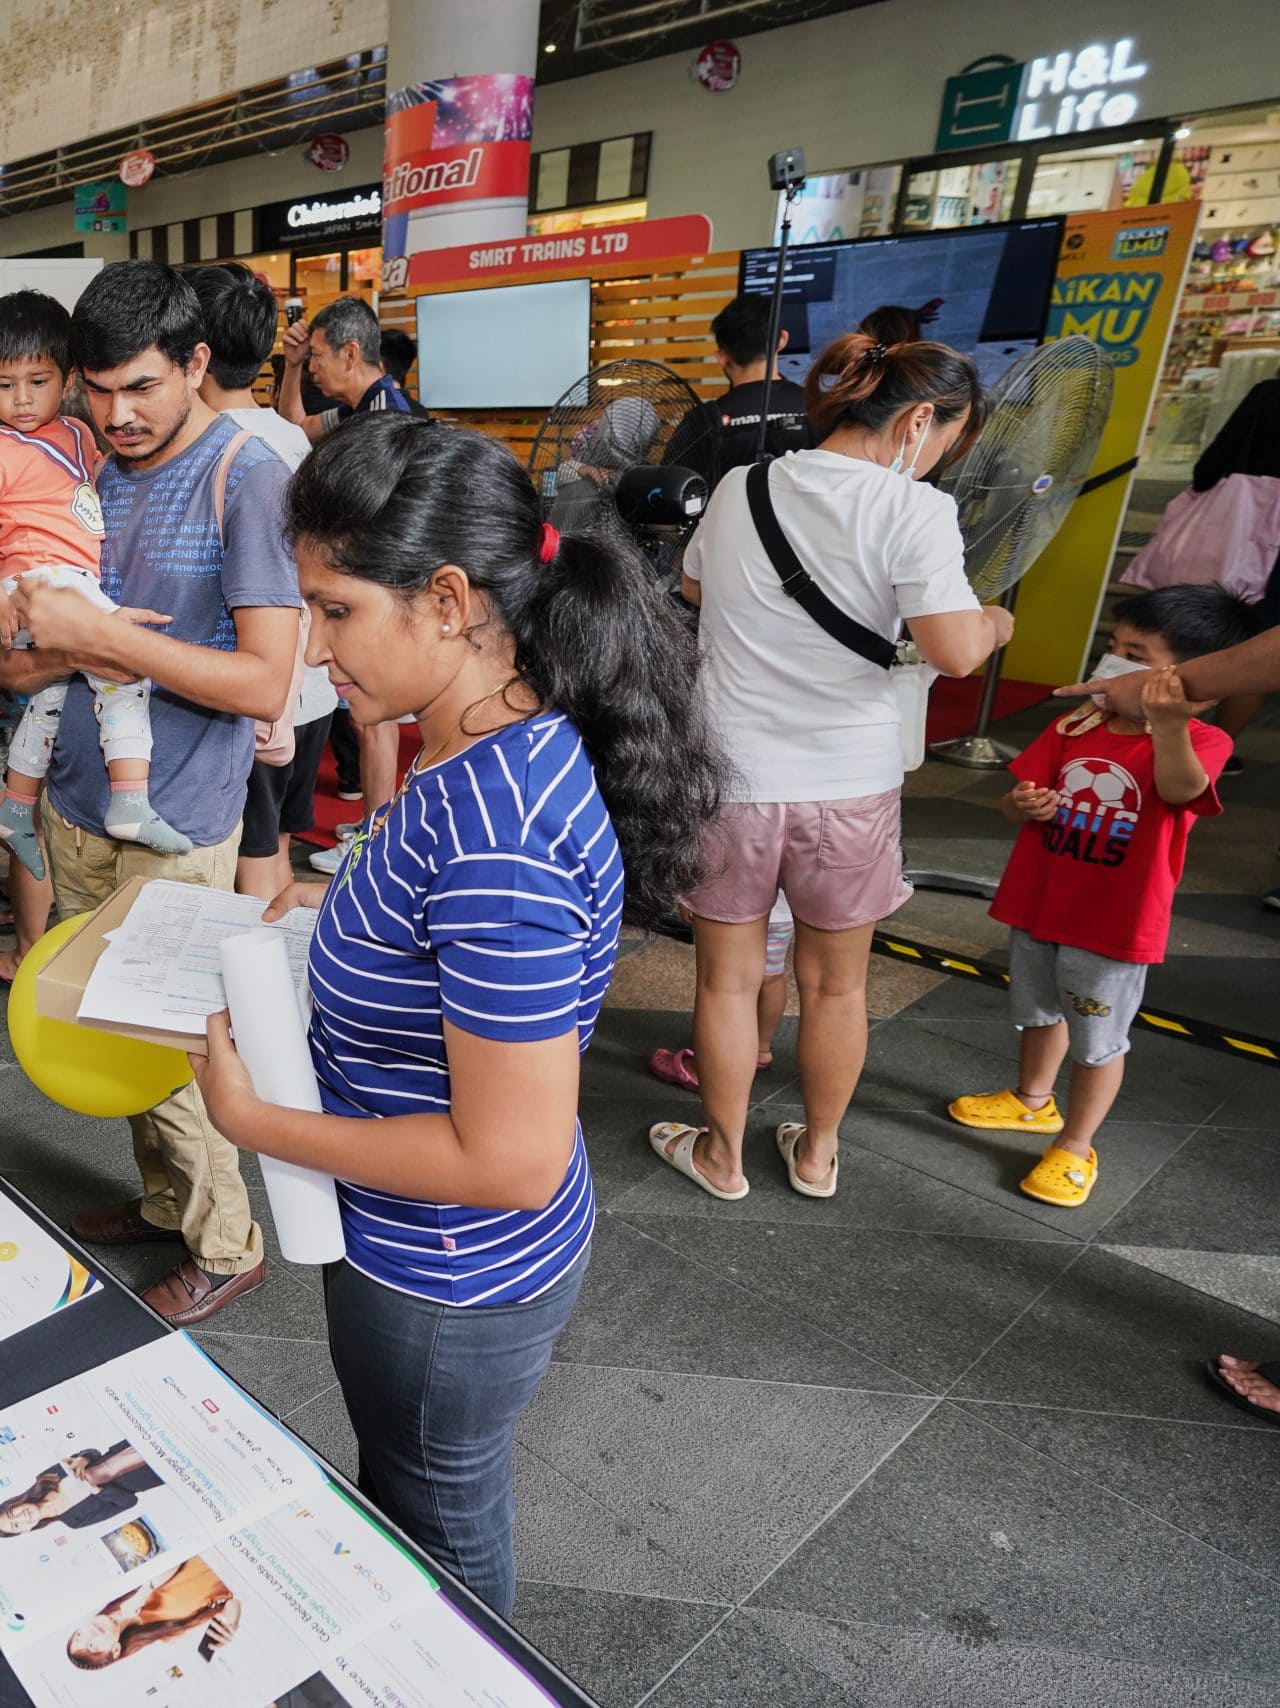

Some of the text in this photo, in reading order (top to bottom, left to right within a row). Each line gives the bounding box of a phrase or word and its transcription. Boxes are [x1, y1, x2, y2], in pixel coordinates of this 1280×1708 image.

[1027, 38, 1148, 98] H&L
[1017, 90, 1139, 141] Life
[469, 231, 629, 269] SMRT TRAINS LTD
[105, 1387, 223, 1522] Reach and Engage More Customers with
[157, 1430, 193, 1468] Advertising
[192, 1468, 213, 1489] Media
[210, 1488, 235, 1515] Social
[240, 1548, 330, 1642] Get Better Leads and
[266, 1555, 308, 1600] Marketing
[354, 1564, 390, 1599] Google
[309, 1600, 341, 1634] Google
[349, 1672, 387, 1708] dvance
